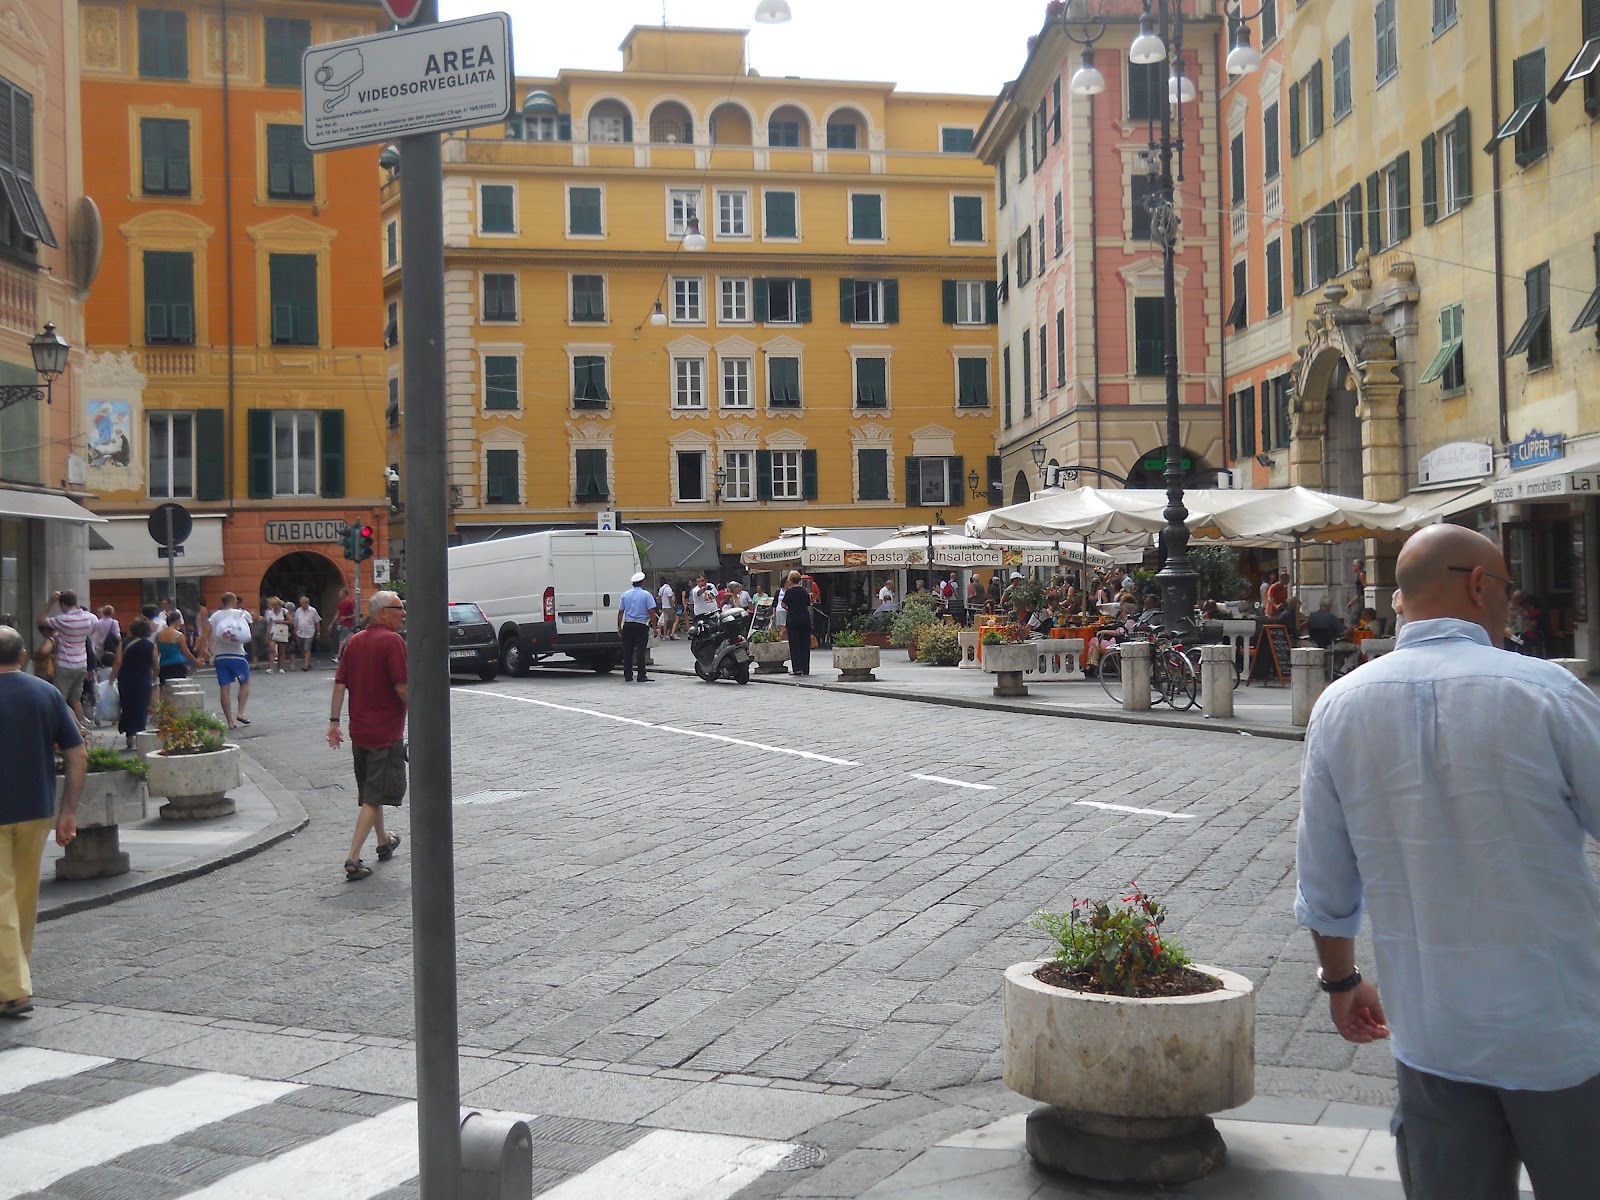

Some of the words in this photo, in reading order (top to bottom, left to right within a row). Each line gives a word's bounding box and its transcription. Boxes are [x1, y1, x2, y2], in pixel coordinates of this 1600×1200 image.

[424, 44, 495, 77] AREA
[358, 68, 496, 104] VIDEOSORVEGLIATA
[1519, 439, 1551, 461] CLIPPER
[1493, 486, 1514, 502] agenzia
[1526, 479, 1562, 496] immobiliare
[1571, 474, 1591, 491] La
[760, 549, 800, 560] Heineken
[809, 551, 842, 565] pizza
[870, 551, 904, 564] pasta
[935, 549, 999, 563] insalatone
